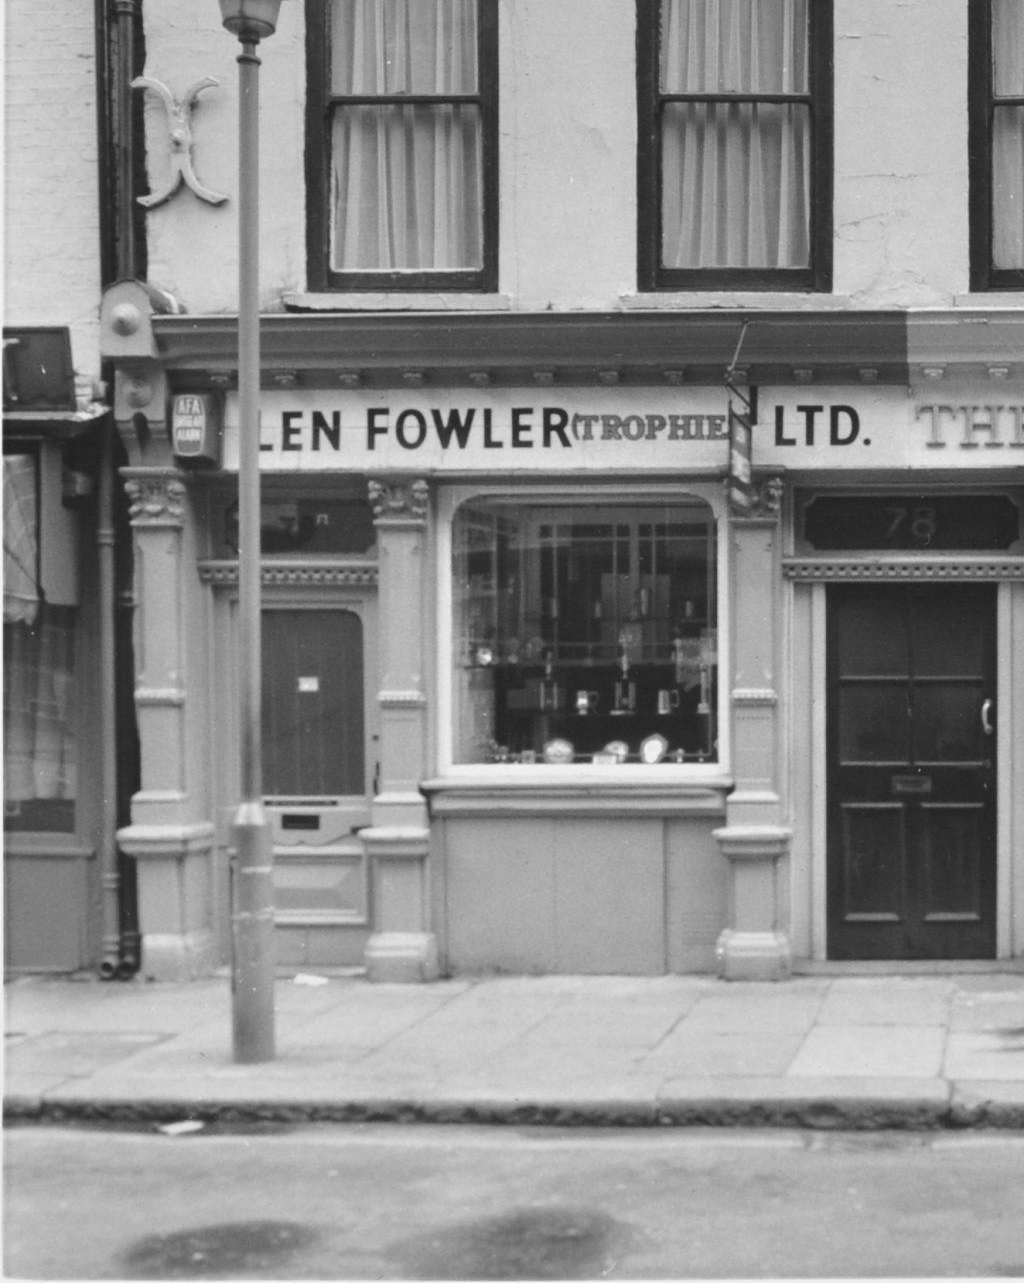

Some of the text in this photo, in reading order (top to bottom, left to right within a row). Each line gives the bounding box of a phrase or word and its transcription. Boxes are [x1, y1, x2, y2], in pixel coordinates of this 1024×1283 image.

[178, 397, 201, 414] AFA
[366, 406, 573, 451] FOWLER
[572, 412, 730, 441] (TROPHIE
[774, 404, 872, 448] LTD.
